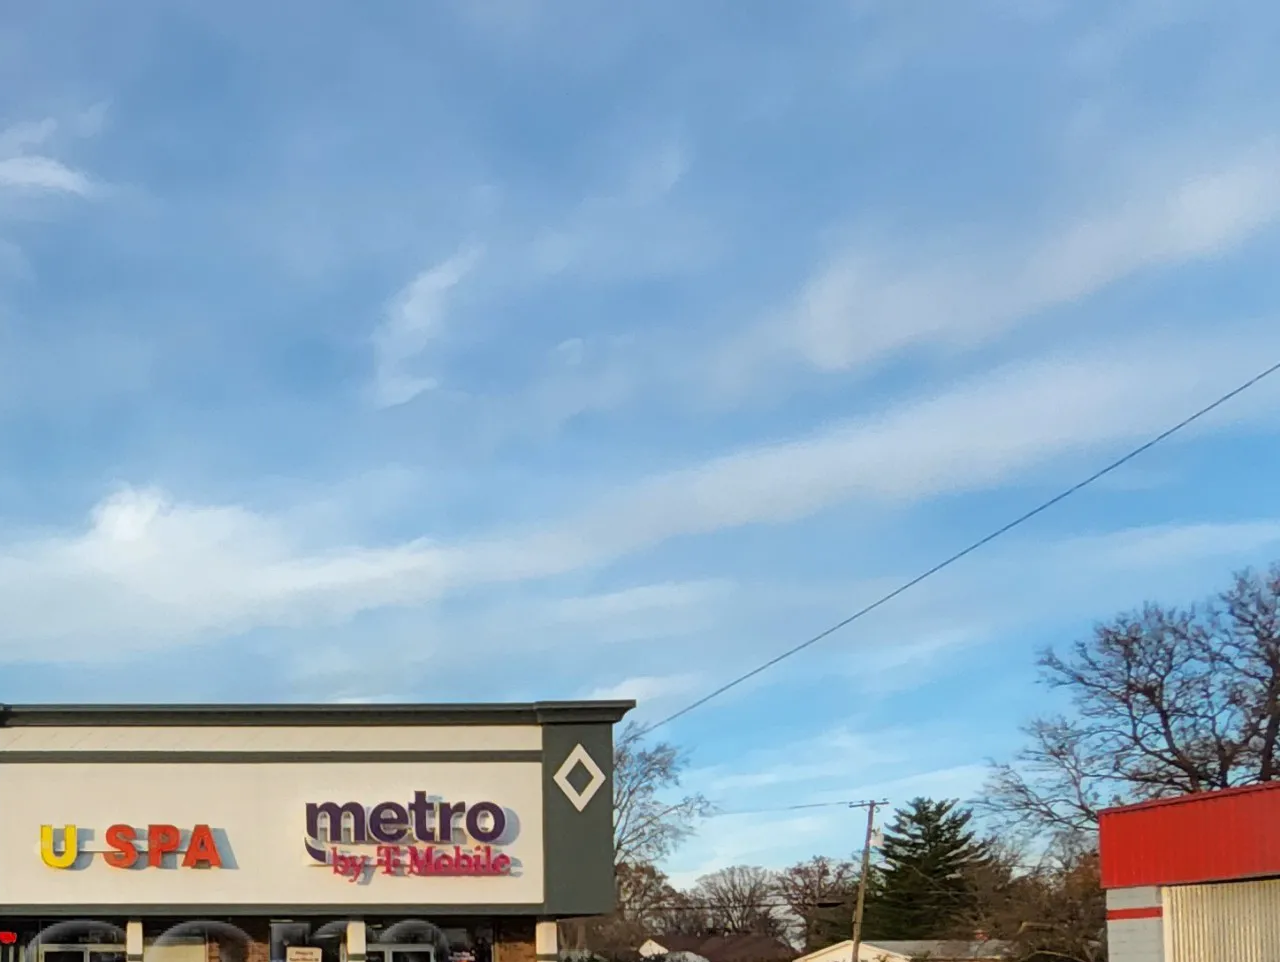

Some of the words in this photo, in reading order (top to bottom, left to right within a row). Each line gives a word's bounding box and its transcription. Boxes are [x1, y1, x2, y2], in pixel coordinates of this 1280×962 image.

[305, 790, 507, 844] metro
[40, 823, 78, 868] U
[103, 823, 223, 869] SPA
[331, 846, 368, 884] by
